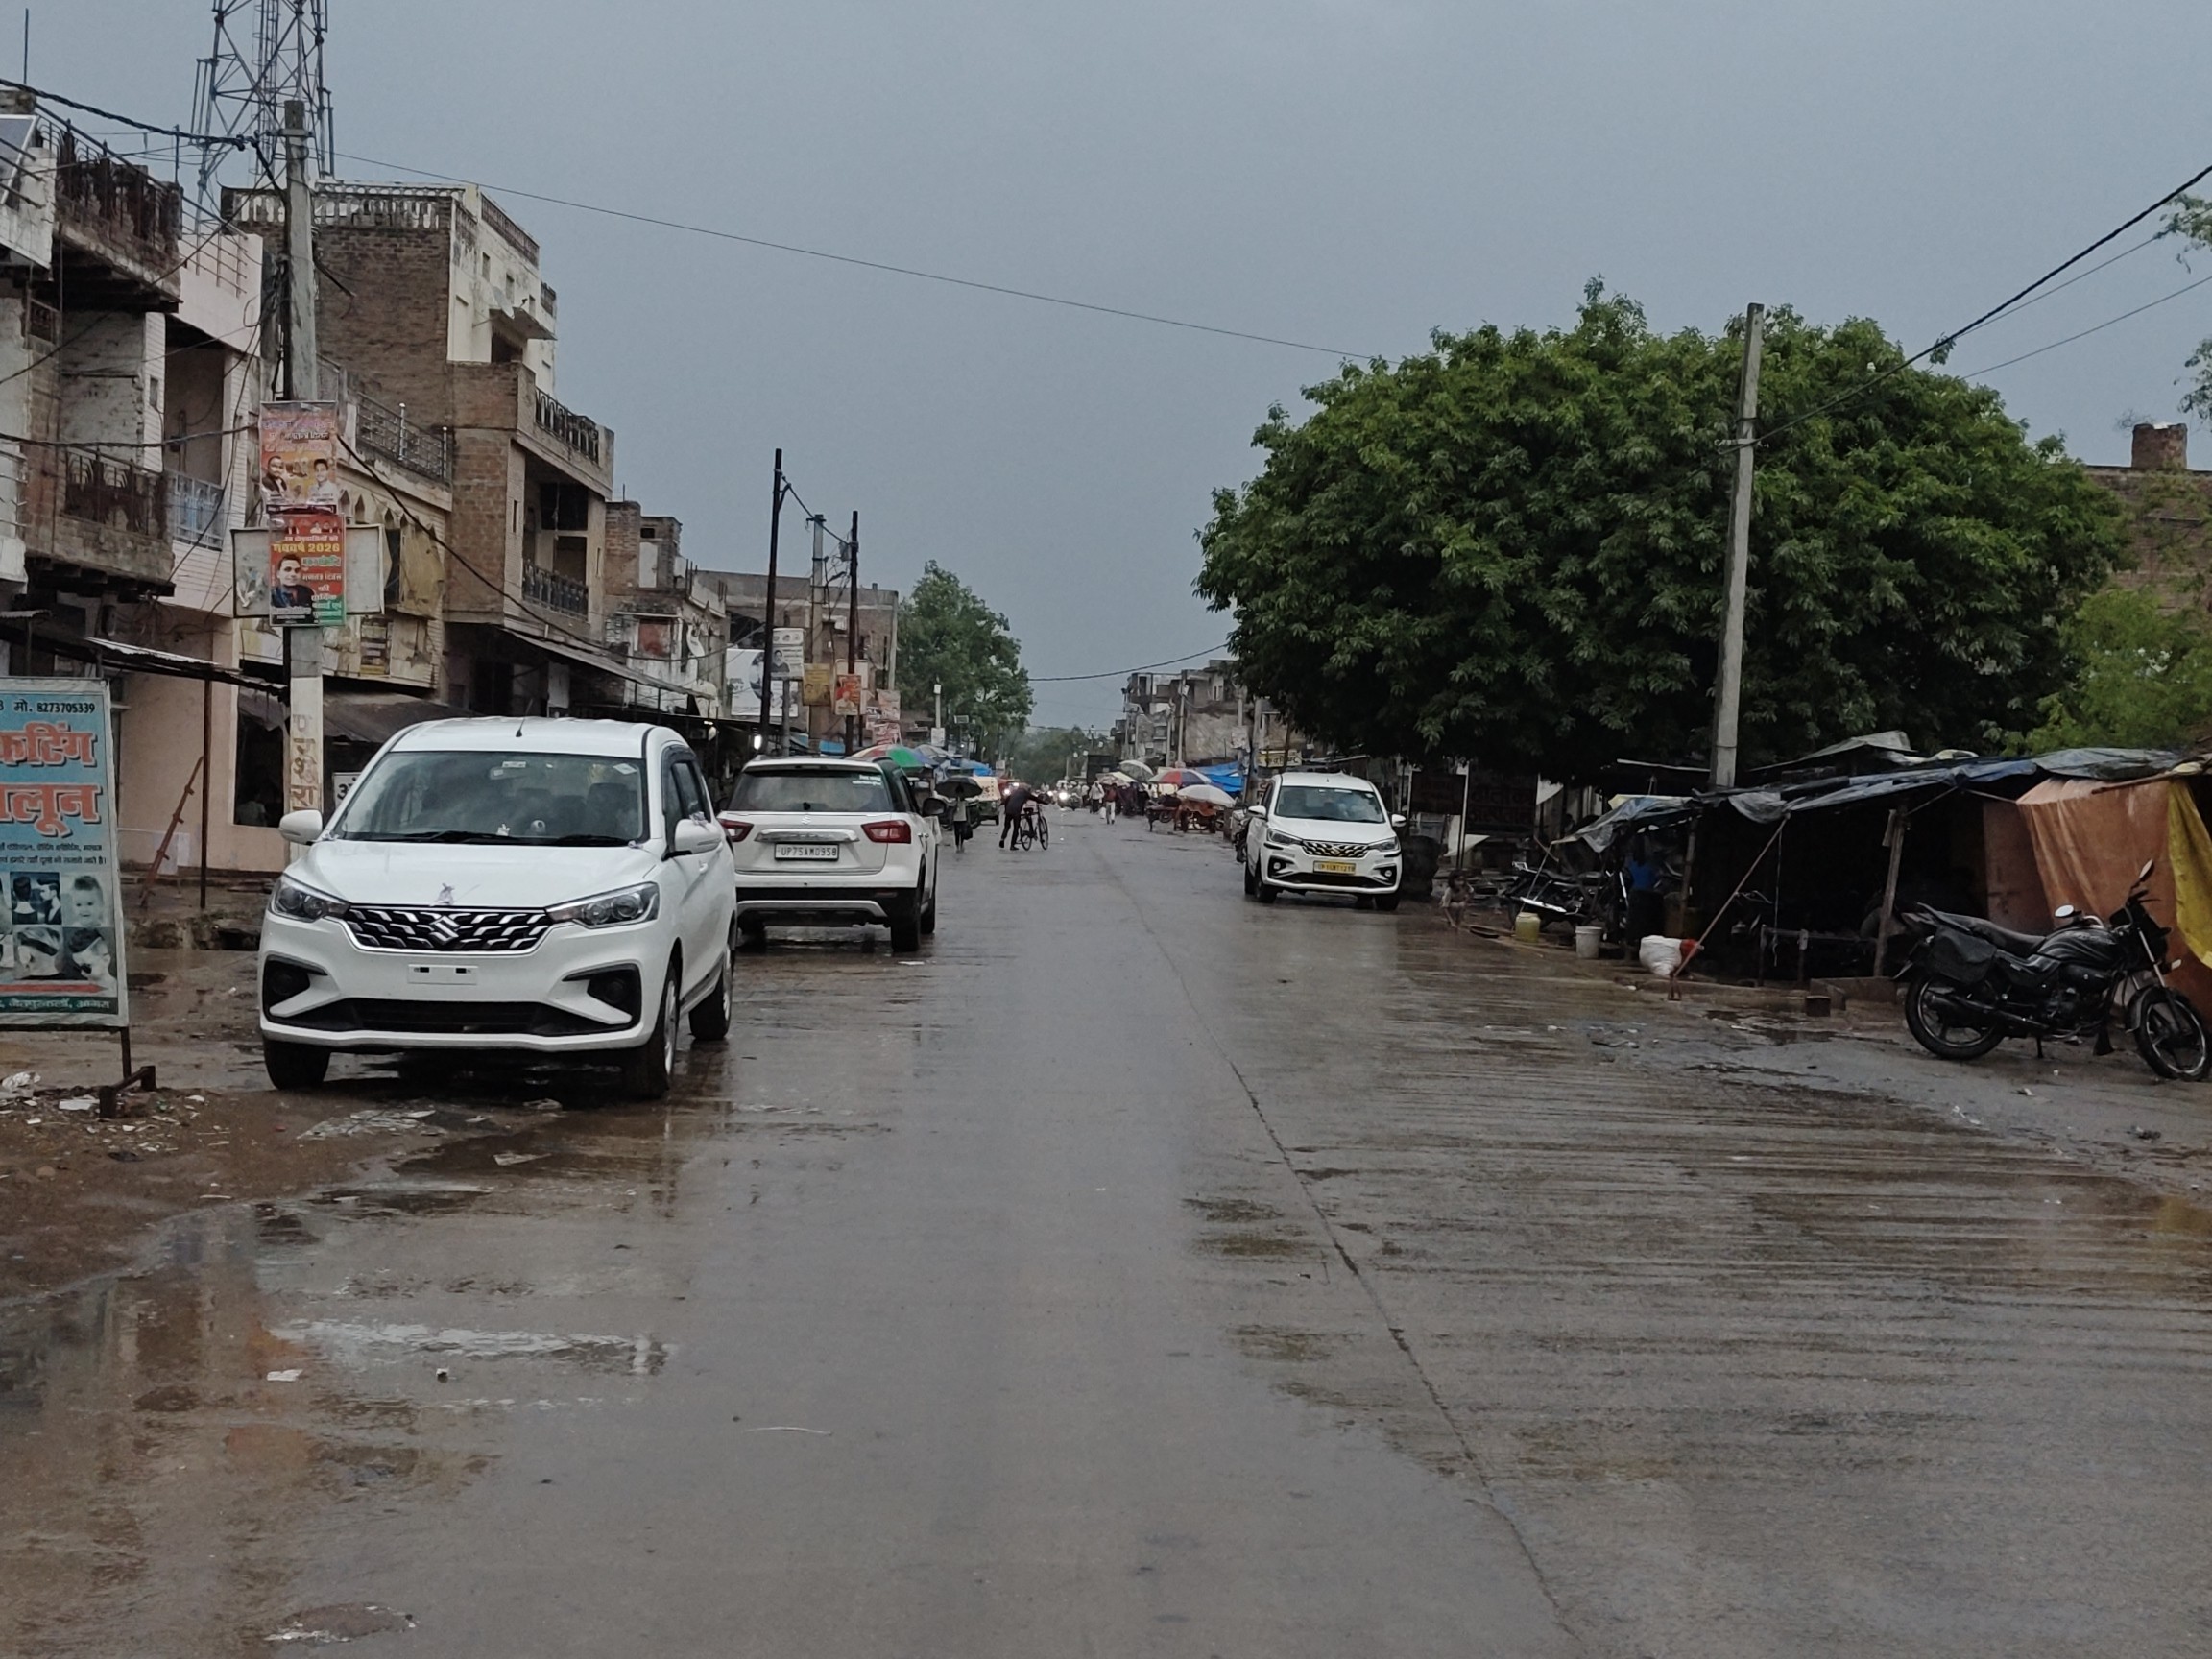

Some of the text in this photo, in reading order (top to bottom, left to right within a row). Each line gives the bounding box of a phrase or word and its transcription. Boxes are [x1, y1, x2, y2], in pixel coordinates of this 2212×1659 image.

[273, 541, 340, 553] नववर्ष 2026
[13, 698, 33, 713] मो.
[36, 702, 95, 715] 8273705339
[0, 783, 102, 836] लून
